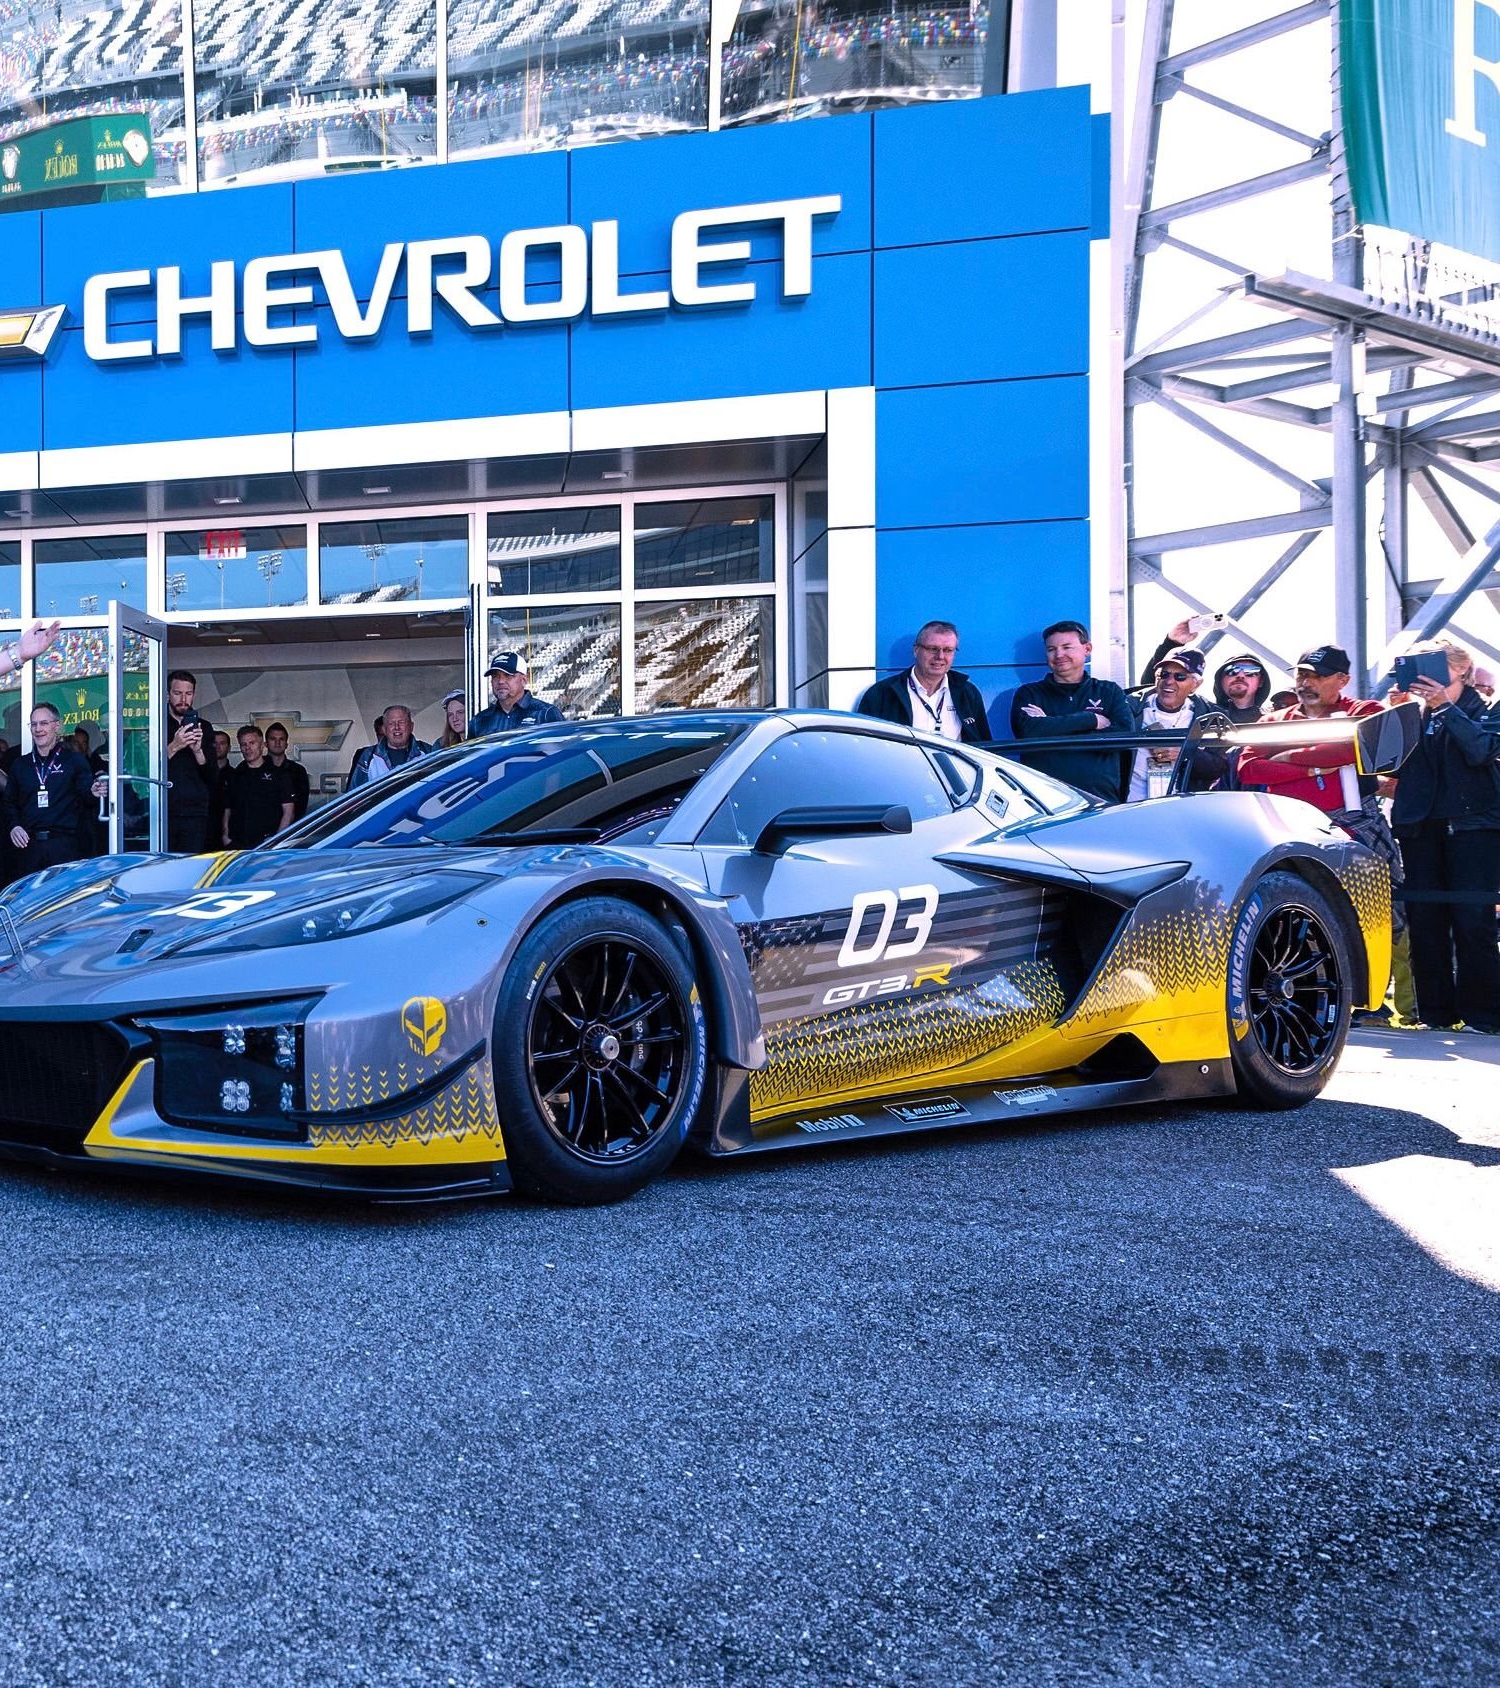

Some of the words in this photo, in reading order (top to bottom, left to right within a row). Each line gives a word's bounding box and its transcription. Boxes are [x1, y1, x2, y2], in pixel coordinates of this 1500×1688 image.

[84, 195, 842, 362] CHEVROLET
[206, 530, 242, 558] EXIT
[838, 883, 940, 968] 03
[1232, 900, 1261, 999] MICHELIN
[822, 963, 952, 1006] GT3.R
[684, 1024, 707, 1129] MICHELIN
[795, 1115, 849, 1133] Mobil
[912, 1102, 960, 1116] MICHELIN
